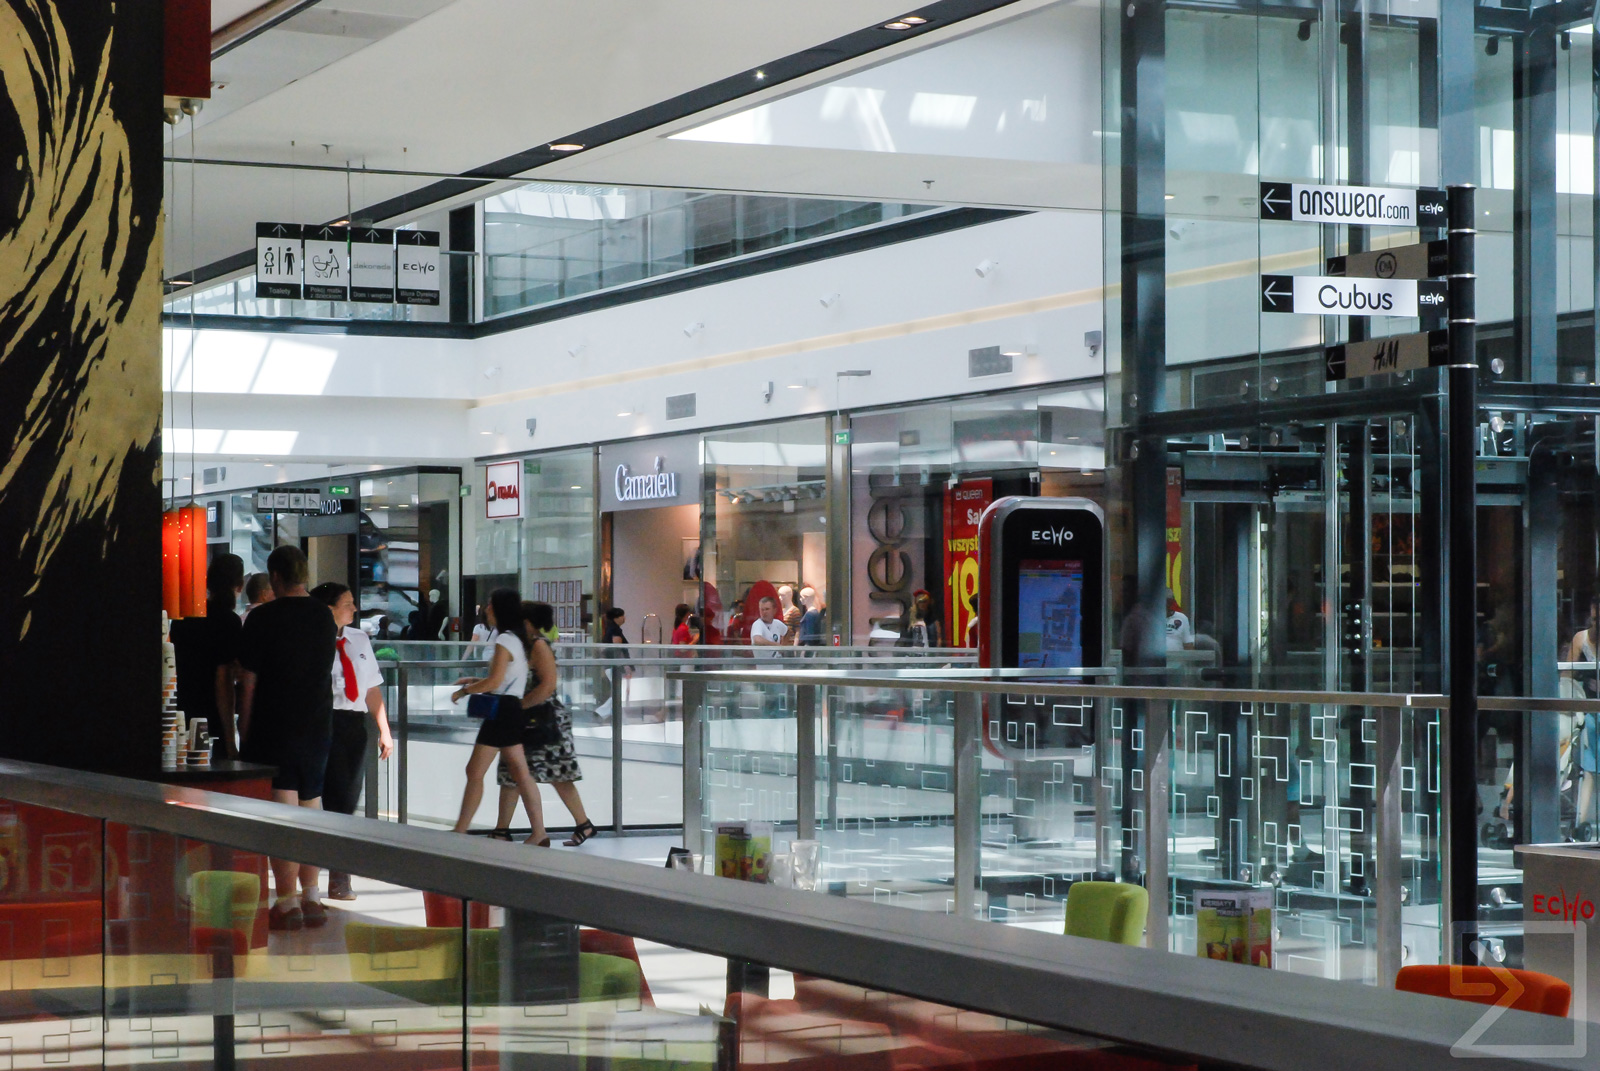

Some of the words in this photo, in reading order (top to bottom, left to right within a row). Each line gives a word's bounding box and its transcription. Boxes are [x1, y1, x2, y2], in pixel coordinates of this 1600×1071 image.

[1299, 189, 1410, 220] answear.com
[1419, 203, 1444, 215] ECHO
[402, 260, 436, 275] ECHO
[1318, 283, 1393, 310] Cubus
[1420, 292, 1445, 305] ECHO
[319, 499, 342, 515] MODA
[1031, 525, 1074, 546] ECHO
[1532, 885, 1596, 929] ECHO
